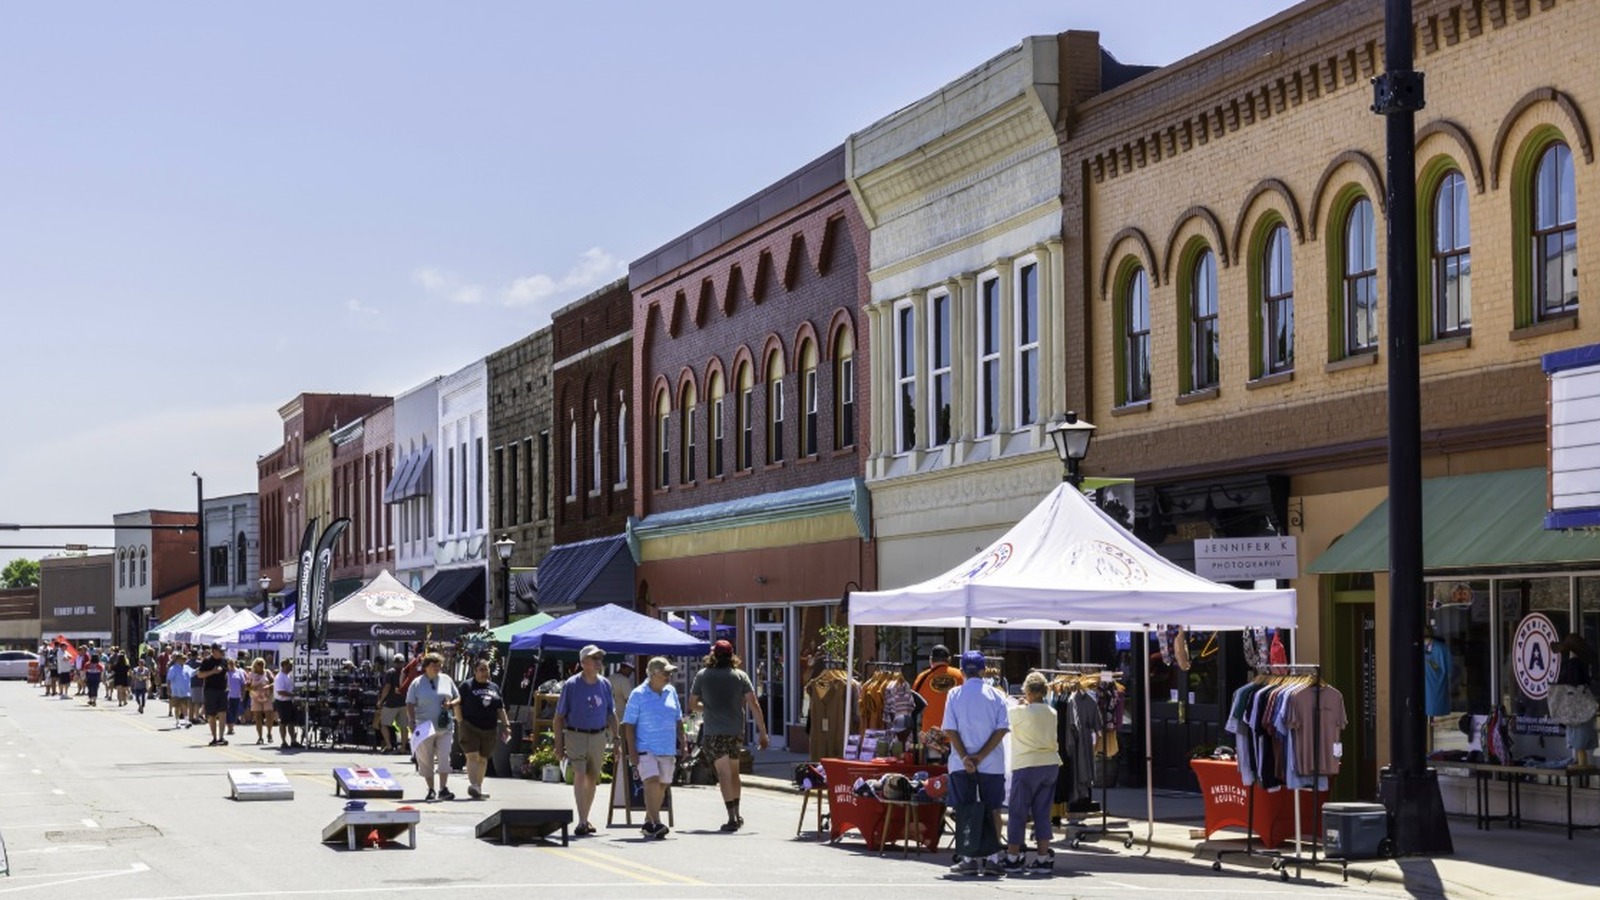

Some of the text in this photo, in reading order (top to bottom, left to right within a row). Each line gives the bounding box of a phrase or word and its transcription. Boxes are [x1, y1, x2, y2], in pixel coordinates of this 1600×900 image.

[1204, 541, 1288, 553] JENNIFER K
[1211, 560, 1281, 569] PHOTOGRAPHY
[1518, 620, 1553, 650] AMERICA
[1528, 642, 1545, 670] A
[1519, 670, 1555, 692] AQUATC
[1211, 784, 1247, 798] AMERICAN
[1215, 794, 1245, 806] AQUATIC
